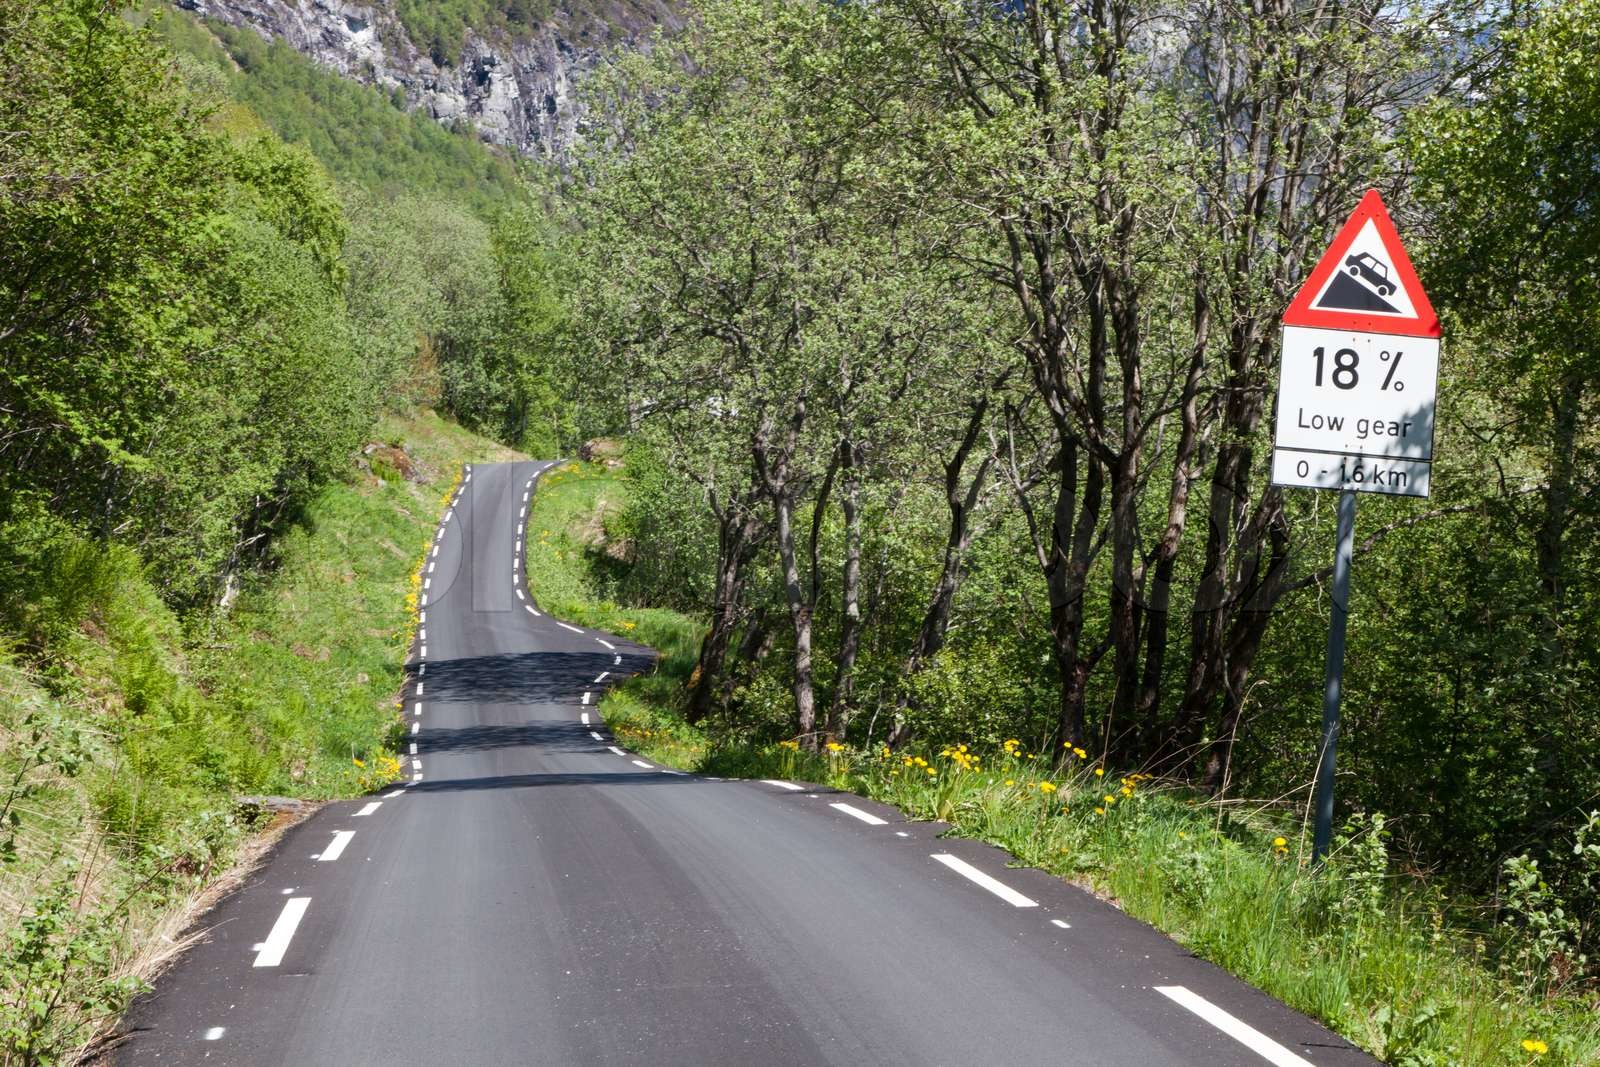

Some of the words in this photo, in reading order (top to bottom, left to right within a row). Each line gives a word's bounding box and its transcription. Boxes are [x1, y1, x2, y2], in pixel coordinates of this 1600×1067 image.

[1313, 346, 1359, 390] 18
[1380, 350, 1404, 392] %
[1298, 407, 1344, 431] Low
[1356, 419, 1412, 440] gear
[1296, 460, 1309, 478] 0
[1373, 464, 1407, 487] km
